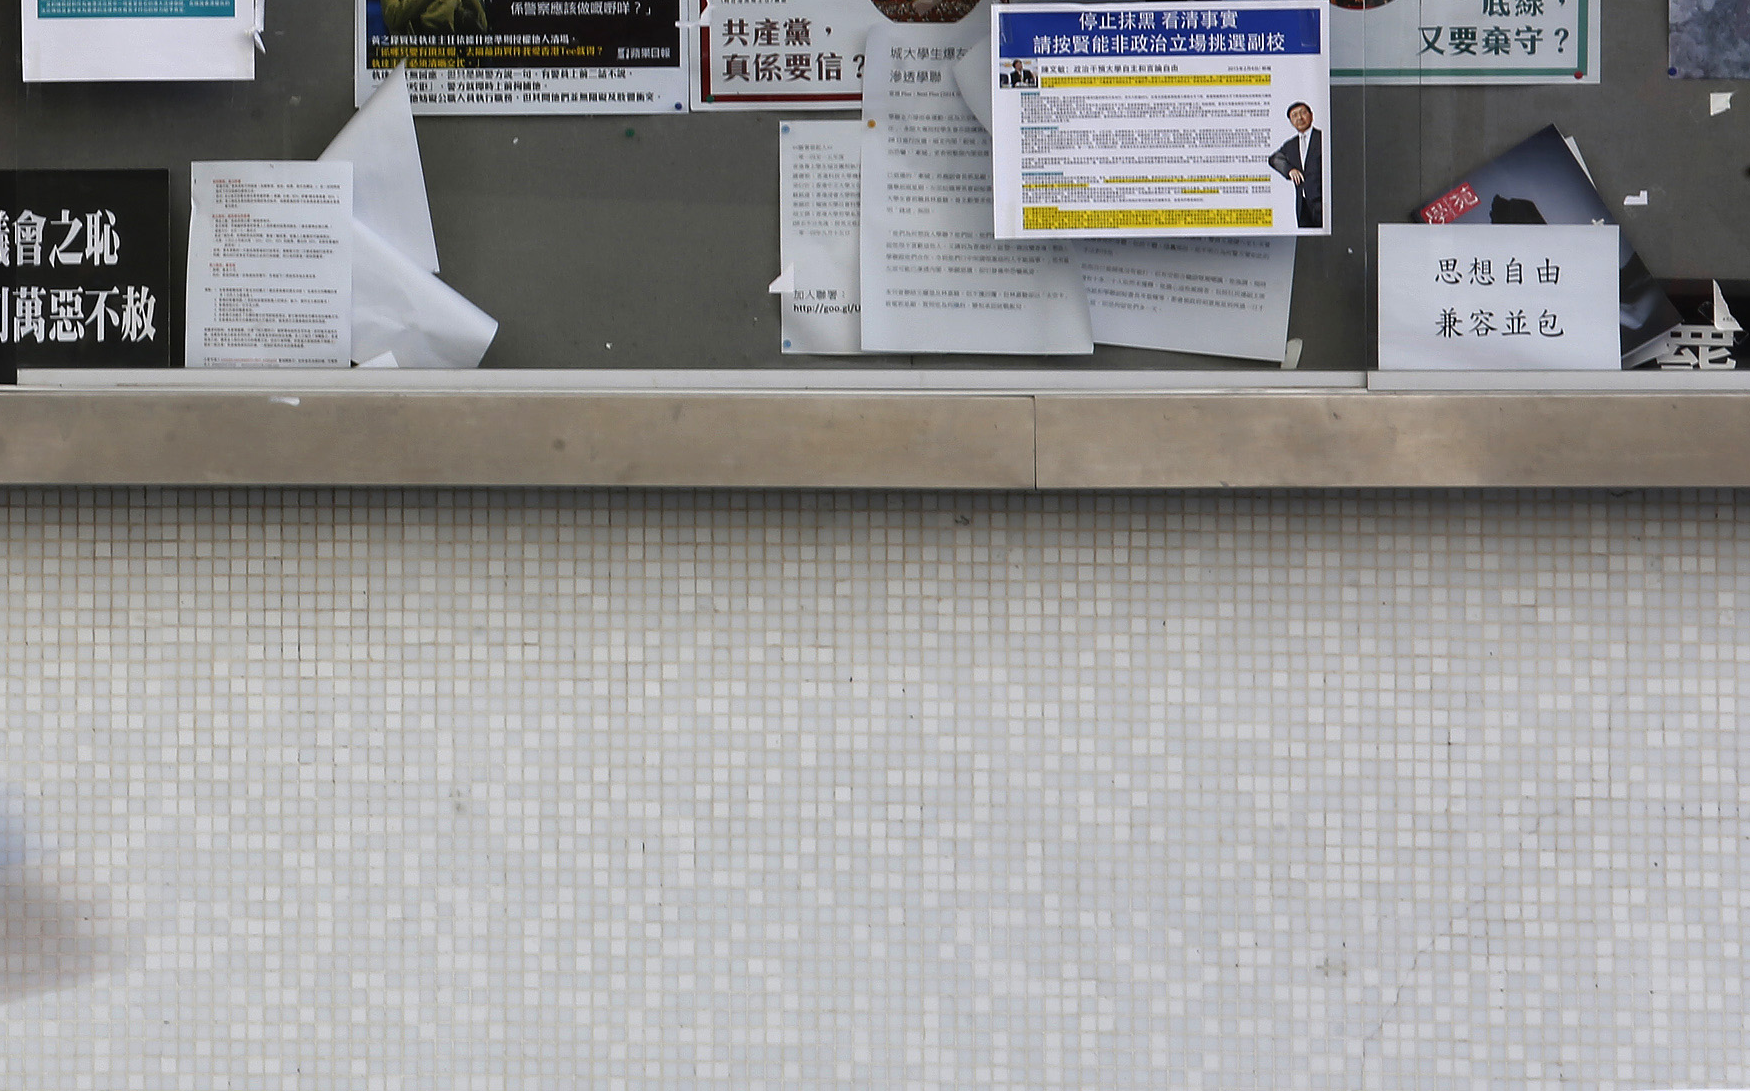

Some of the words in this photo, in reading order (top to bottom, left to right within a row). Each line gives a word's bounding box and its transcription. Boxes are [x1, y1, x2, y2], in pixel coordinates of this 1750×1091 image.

[723, 17, 832, 47] 共產黨，
[1079, 12, 1156, 31] 停止抹黑
[1161, 10, 1239, 30] 看清事實
[890, 47, 965, 61] 城大學生爆友
[1033, 32, 1286, 54] 請按賢能非政治立場挑選副校
[1417, 26, 1570, 57] 又要棄守？
[722, 53, 866, 83] 真係要信？
[889, 71, 943, 84] 滲透學聯
[1434, 257, 1562, 287] 思想自由
[1434, 308, 1565, 338] 兼容並包
